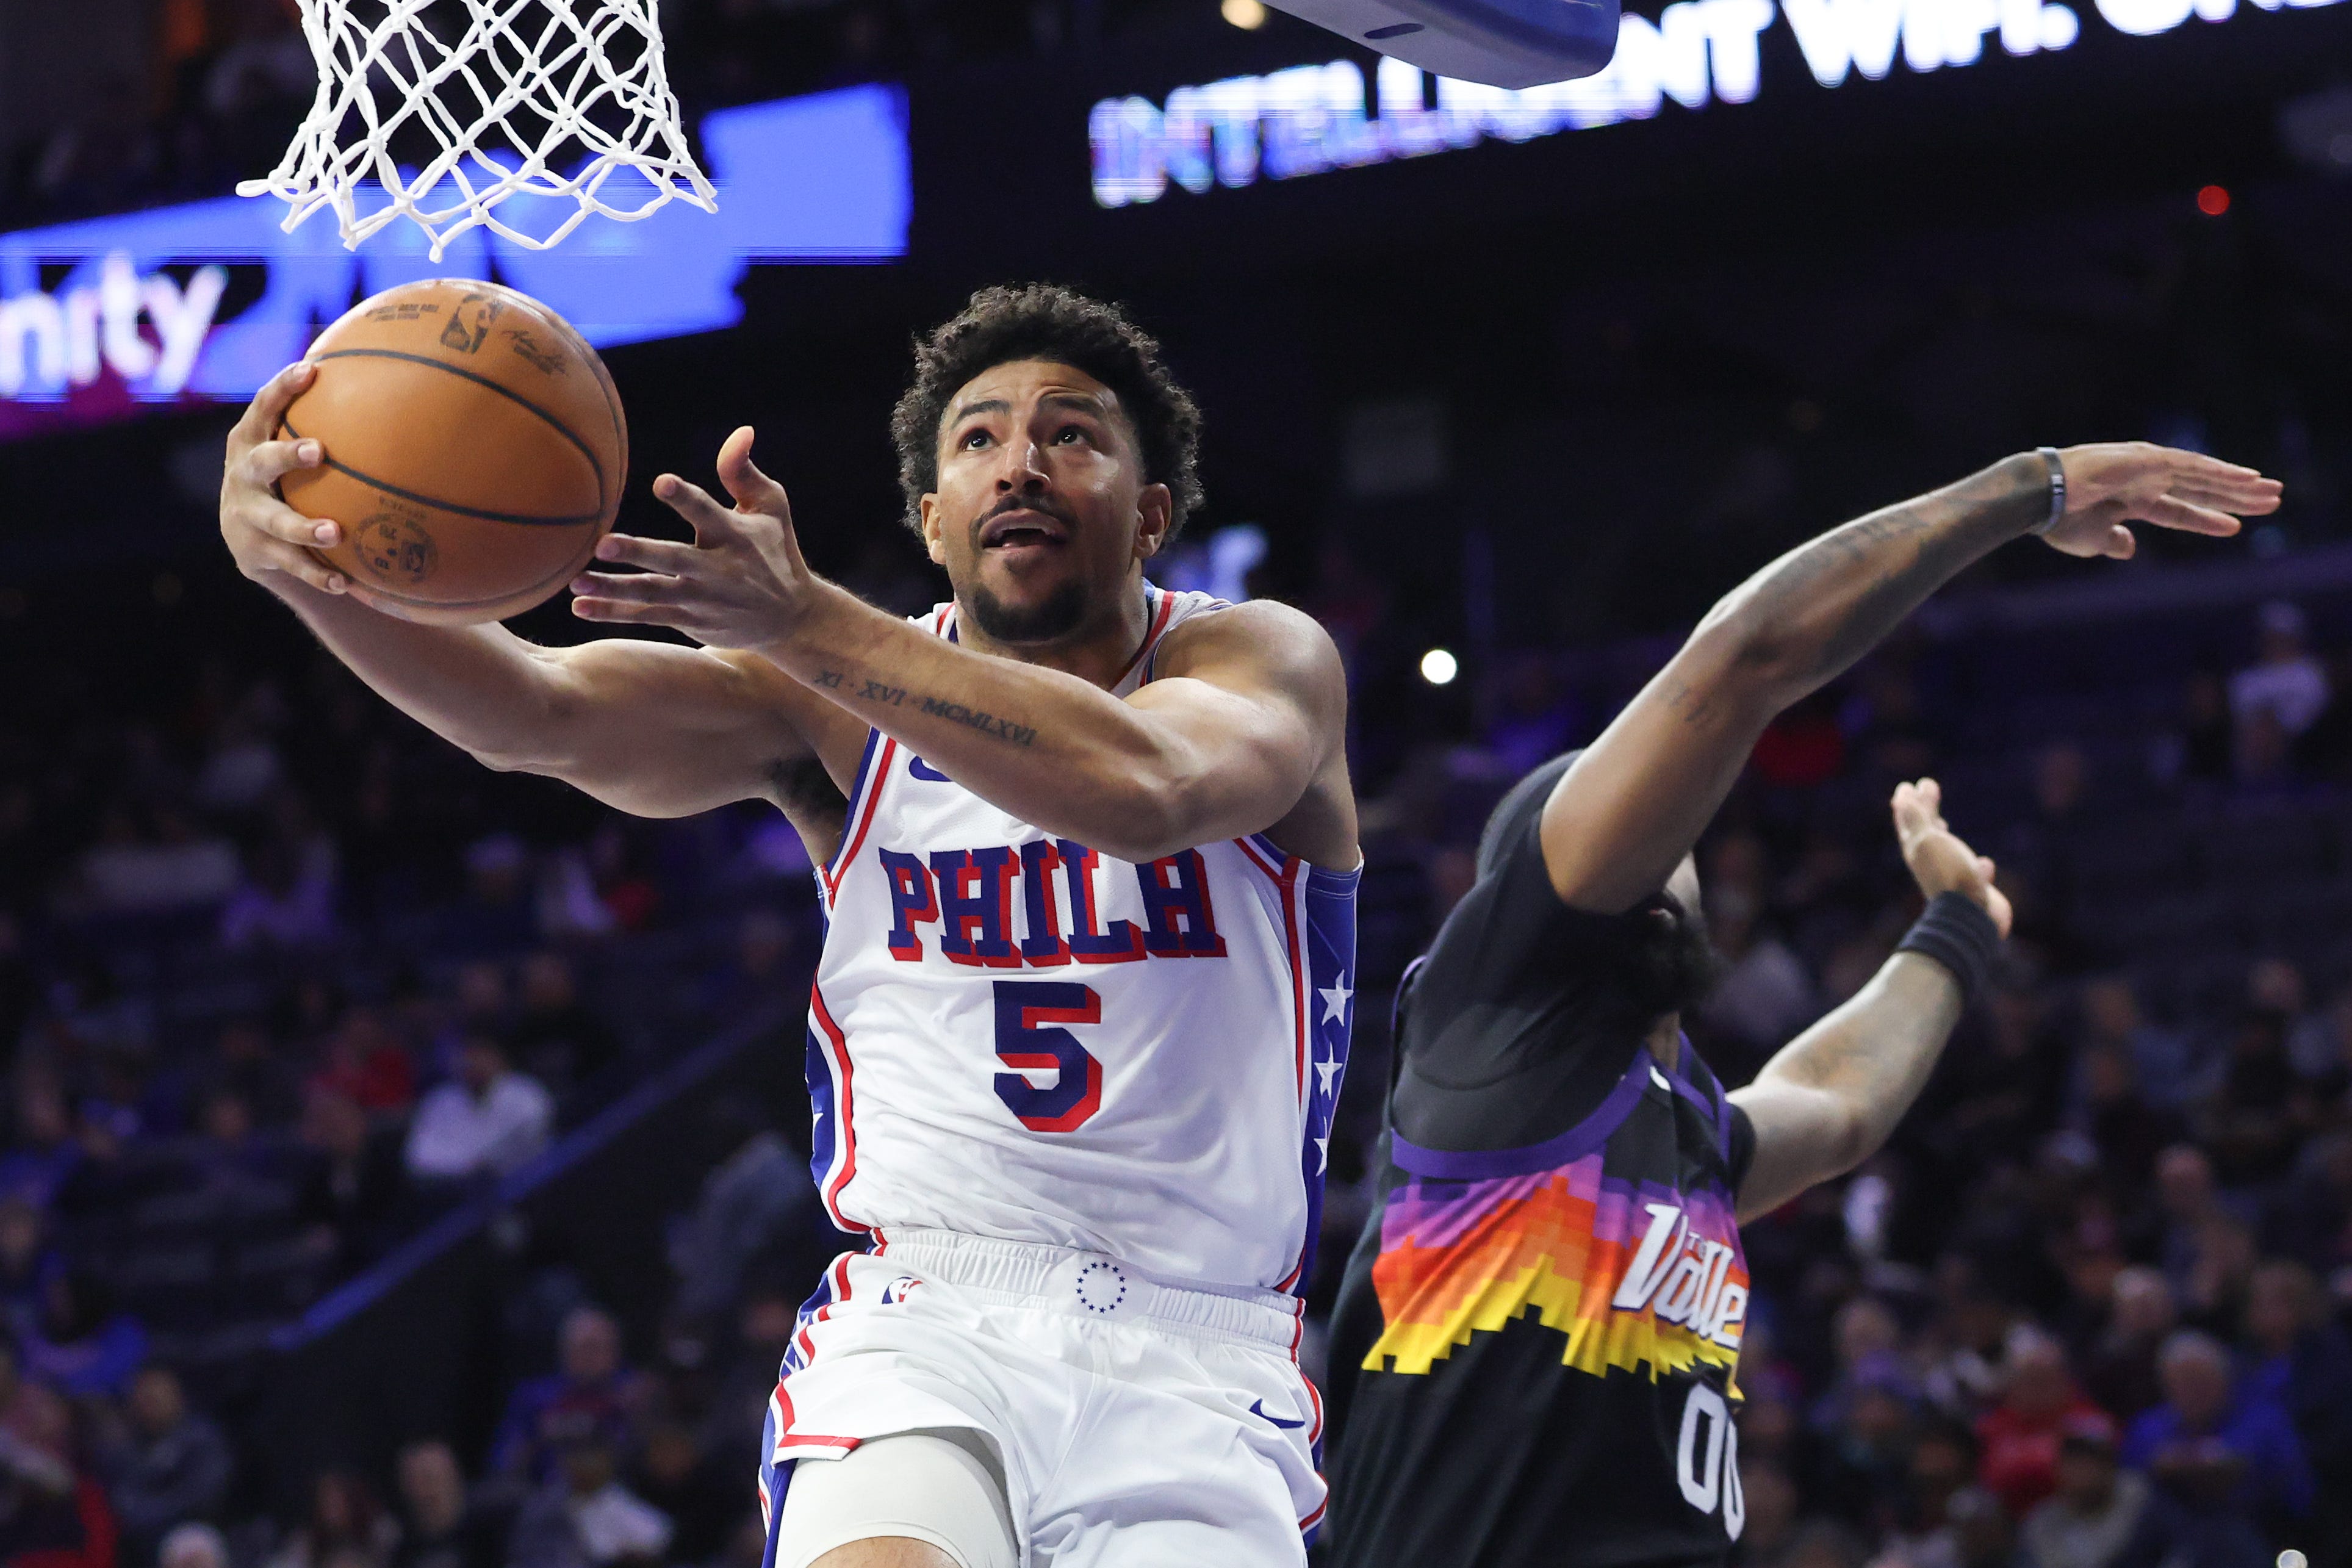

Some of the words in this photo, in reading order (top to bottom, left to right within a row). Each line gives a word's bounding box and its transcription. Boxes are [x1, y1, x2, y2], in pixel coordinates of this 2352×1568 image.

[857, 678, 907, 706] XVI
[879, 838, 1228, 968] PHILA
[993, 980, 1102, 1132] 5
